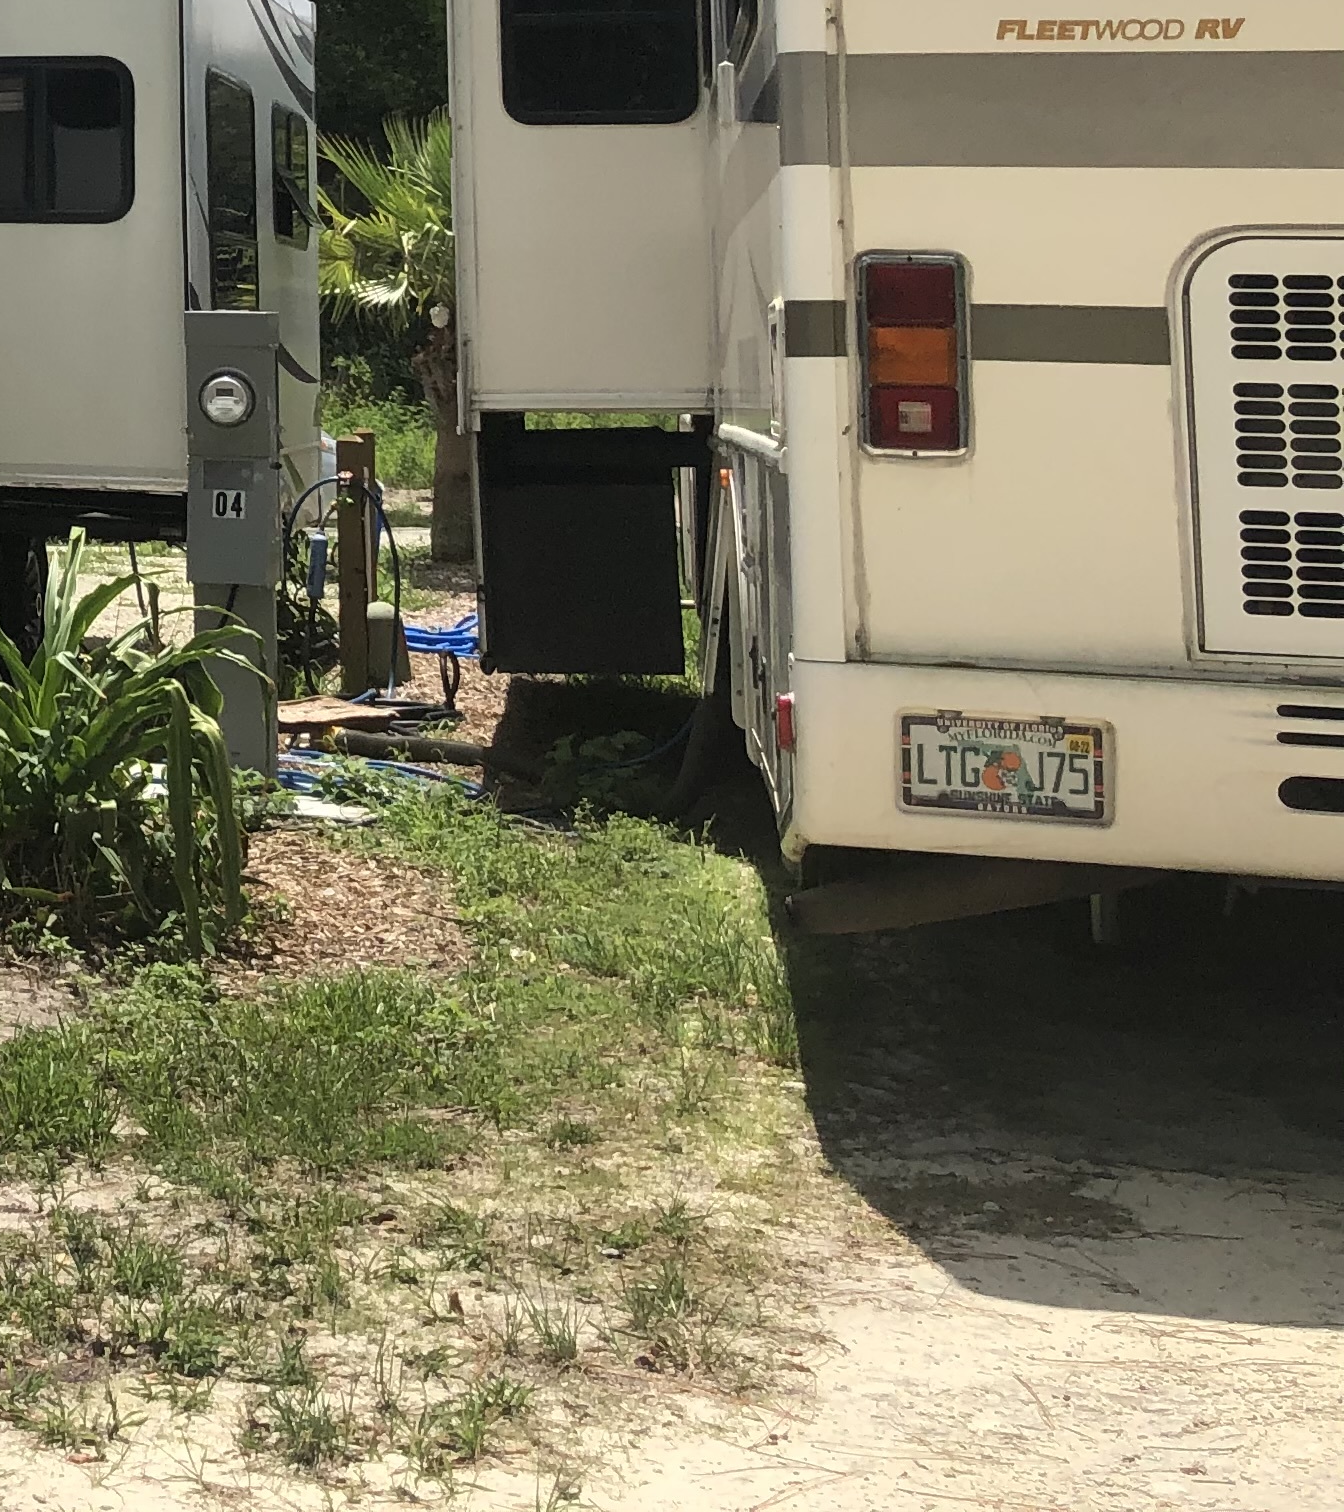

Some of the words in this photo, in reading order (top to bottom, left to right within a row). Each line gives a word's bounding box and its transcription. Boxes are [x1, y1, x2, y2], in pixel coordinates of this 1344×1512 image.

[996, 18, 1185, 41] FLEETWOOD
[1195, 17, 1246, 40] RV
[215, 491, 243, 518] 04
[916, 743, 981, 788] LTG
[1025, 750, 1090, 795] J75
